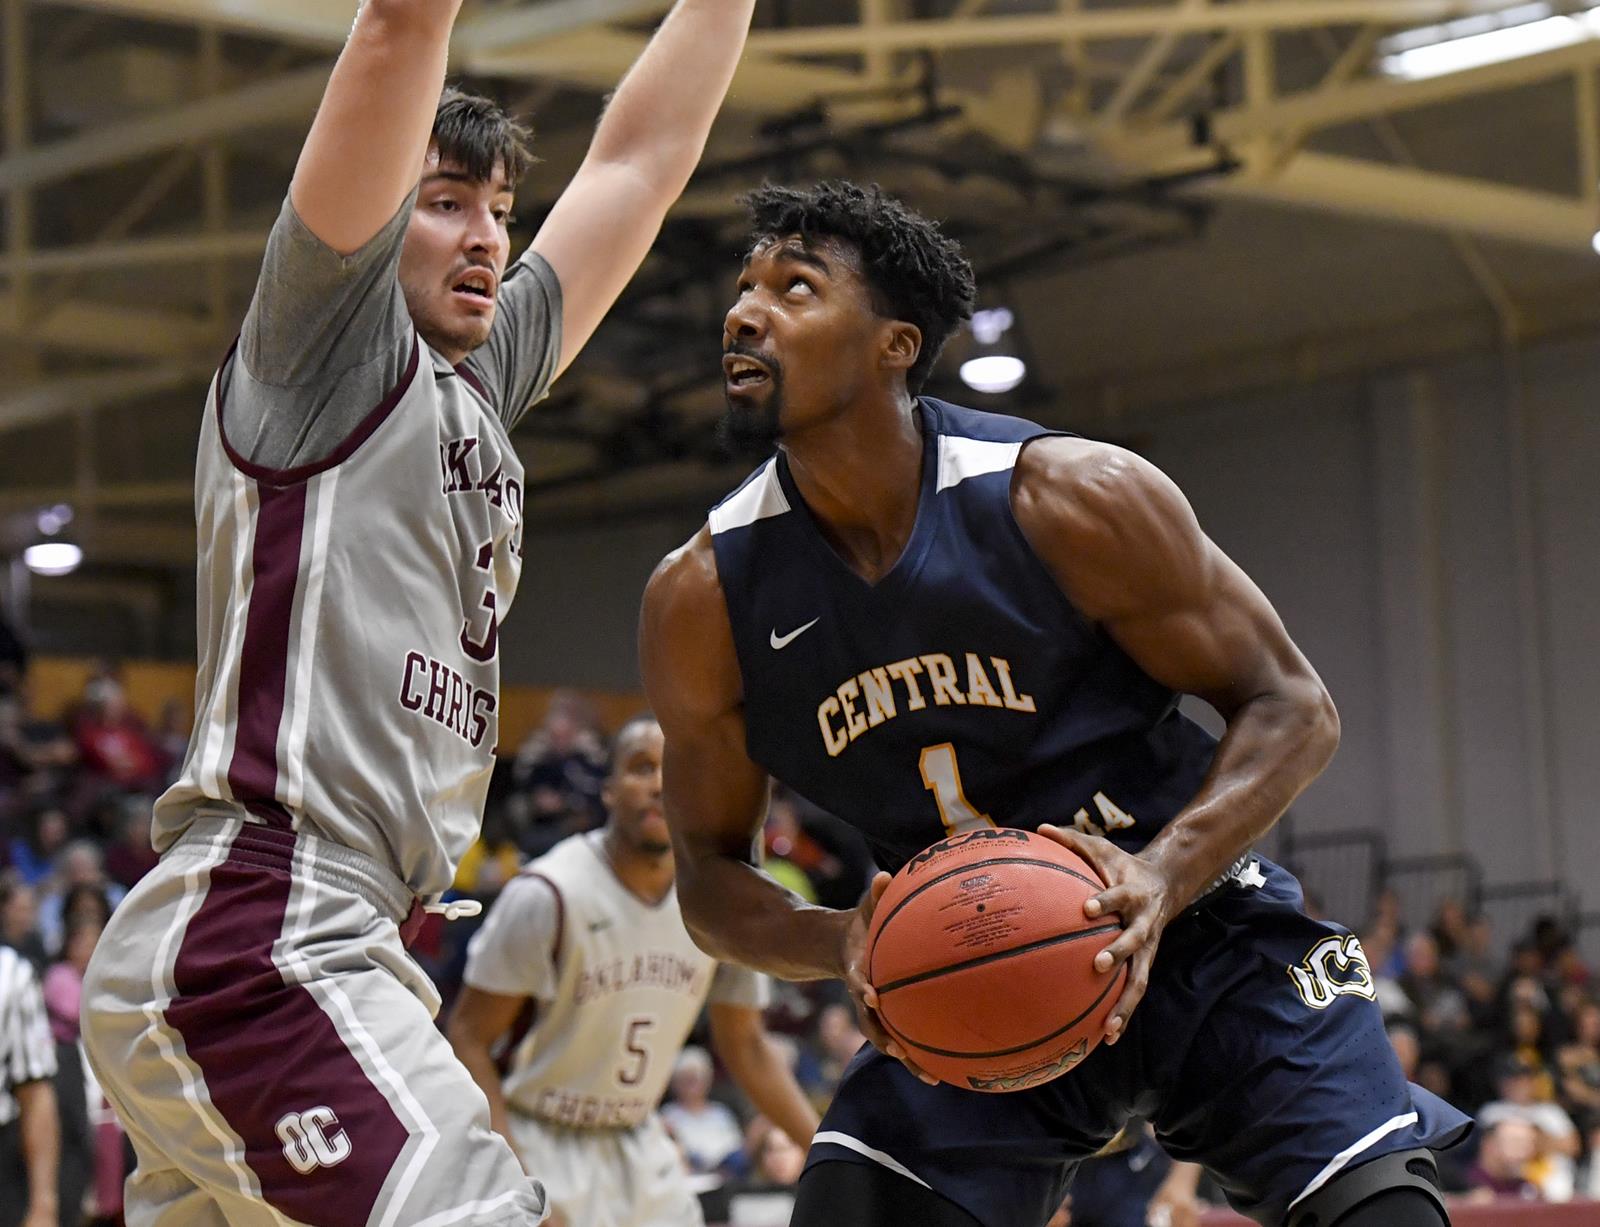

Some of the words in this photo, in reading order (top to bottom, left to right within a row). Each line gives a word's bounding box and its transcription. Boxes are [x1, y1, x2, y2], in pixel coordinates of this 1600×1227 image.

[399, 649, 499, 756] CHRIS
[816, 652, 1037, 757] CENTRAL
[918, 741, 998, 837] 1
[618, 1017, 655, 1086] 5
[274, 1105, 353, 1175] OC
